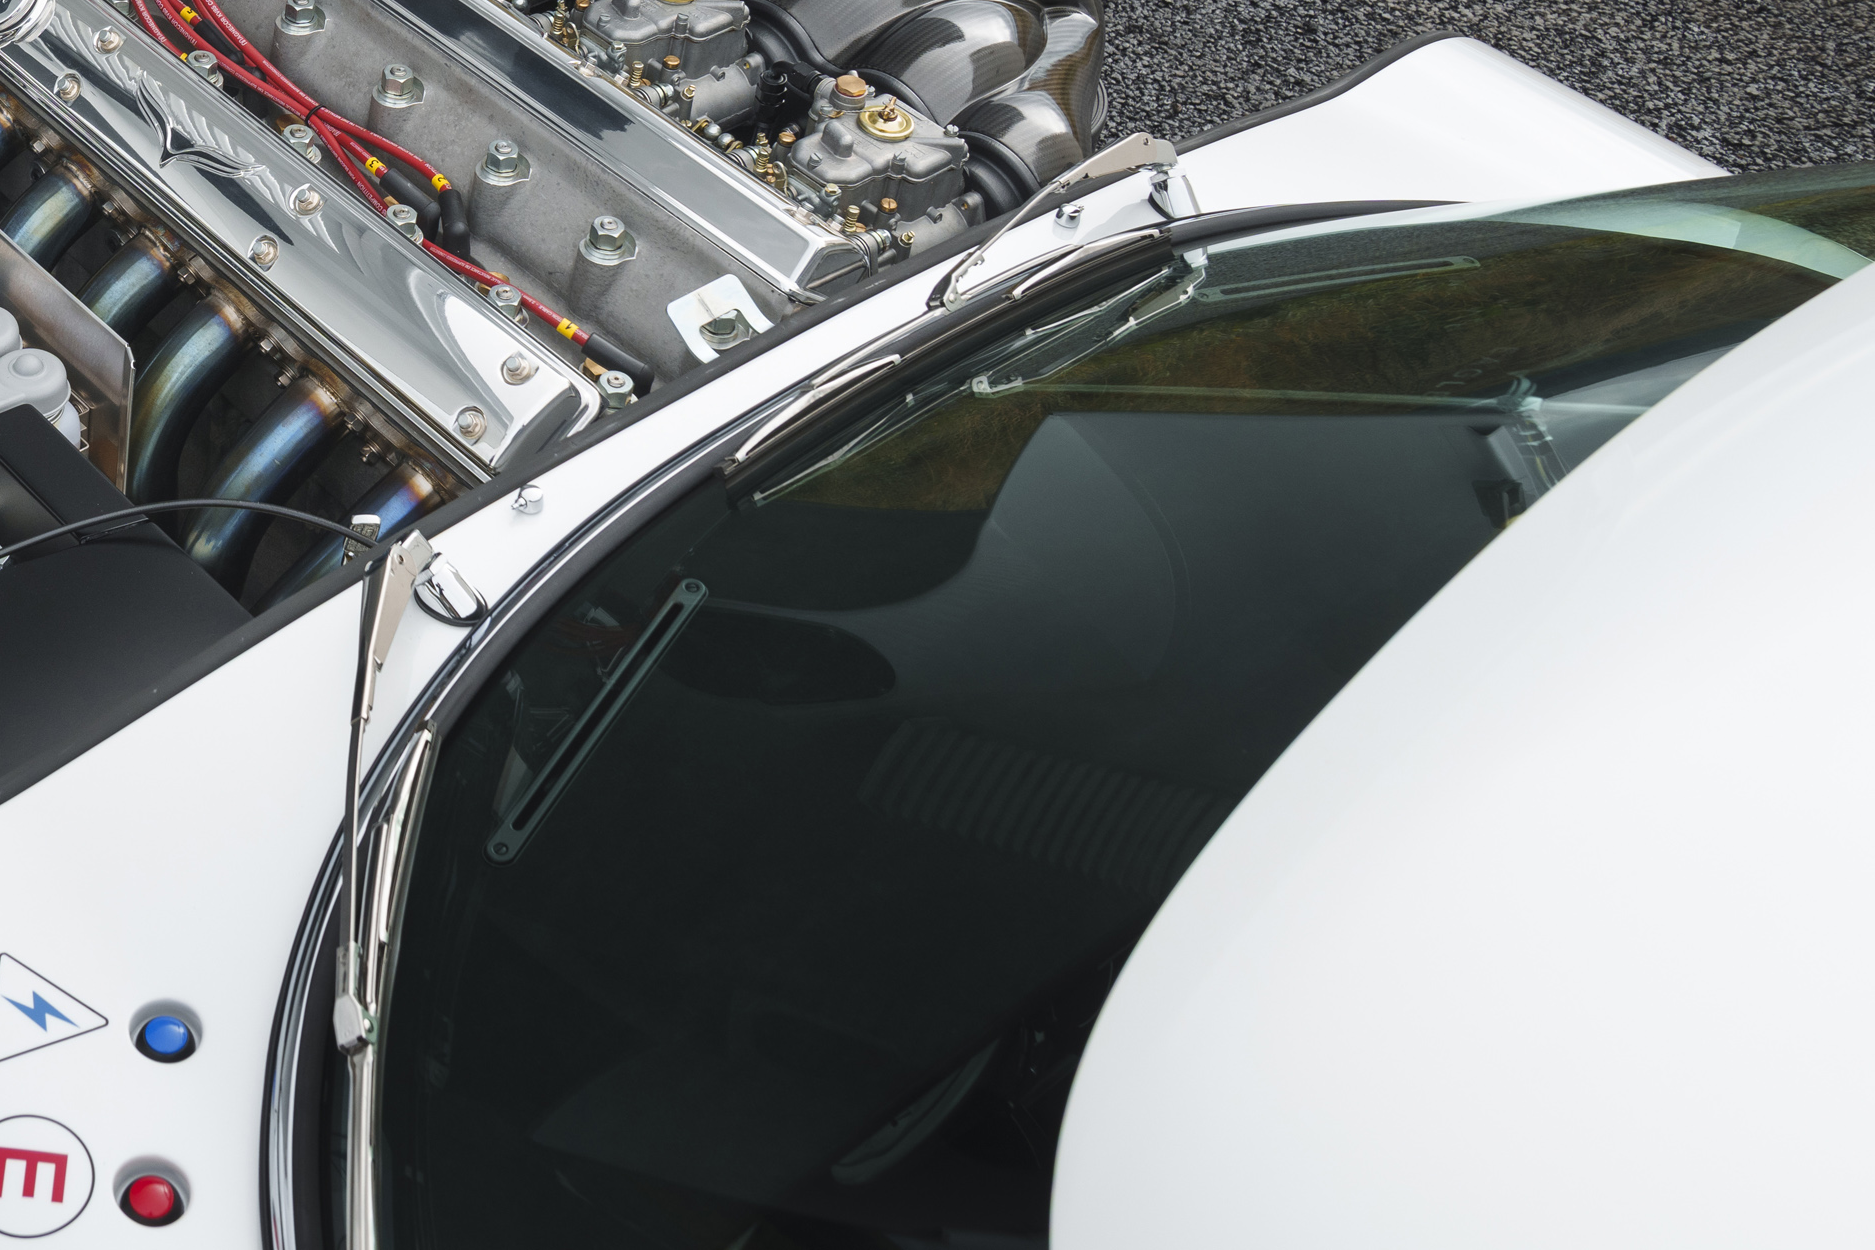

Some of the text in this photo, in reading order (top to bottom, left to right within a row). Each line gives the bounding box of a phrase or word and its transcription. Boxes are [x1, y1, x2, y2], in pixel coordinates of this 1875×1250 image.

[141, 10, 166, 43] MAGNECOR
[171, 17, 197, 45] MAGNECOR
[220, 16, 247, 46] MAGNECOR
[369, 159, 379, 168] 3
[356, 180, 383, 210] COMPETITION
